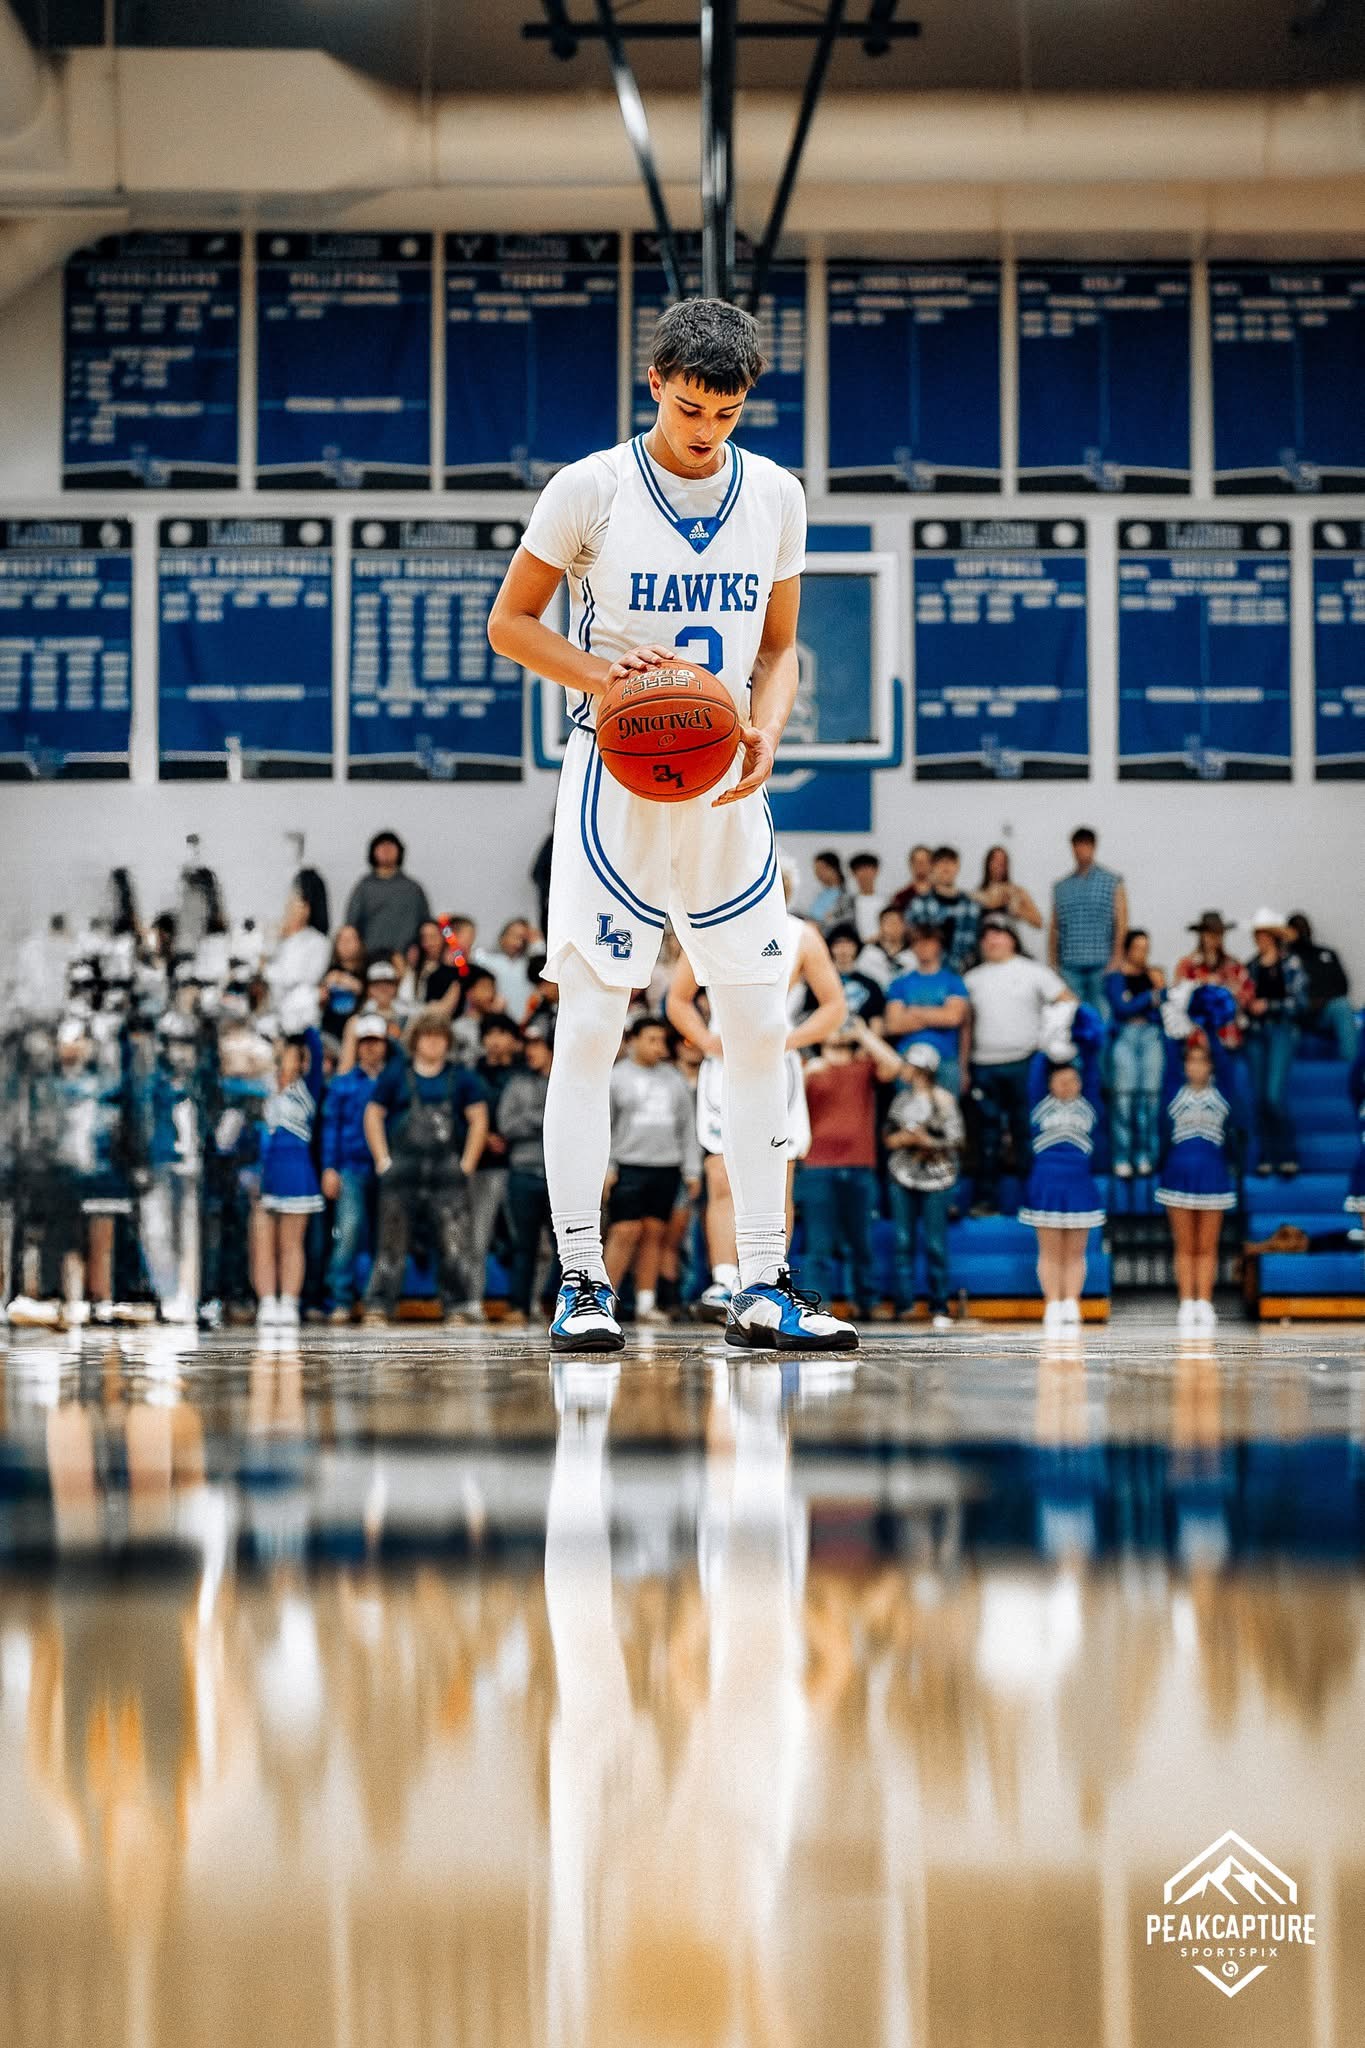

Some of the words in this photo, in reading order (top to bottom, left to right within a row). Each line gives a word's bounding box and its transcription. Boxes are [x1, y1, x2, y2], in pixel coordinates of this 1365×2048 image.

[689, 532, 710, 540] adidas
[629, 573, 759, 613] HAWKS
[621, 676, 703, 700] LEGACY
[617, 706, 713, 740] SPALDING
